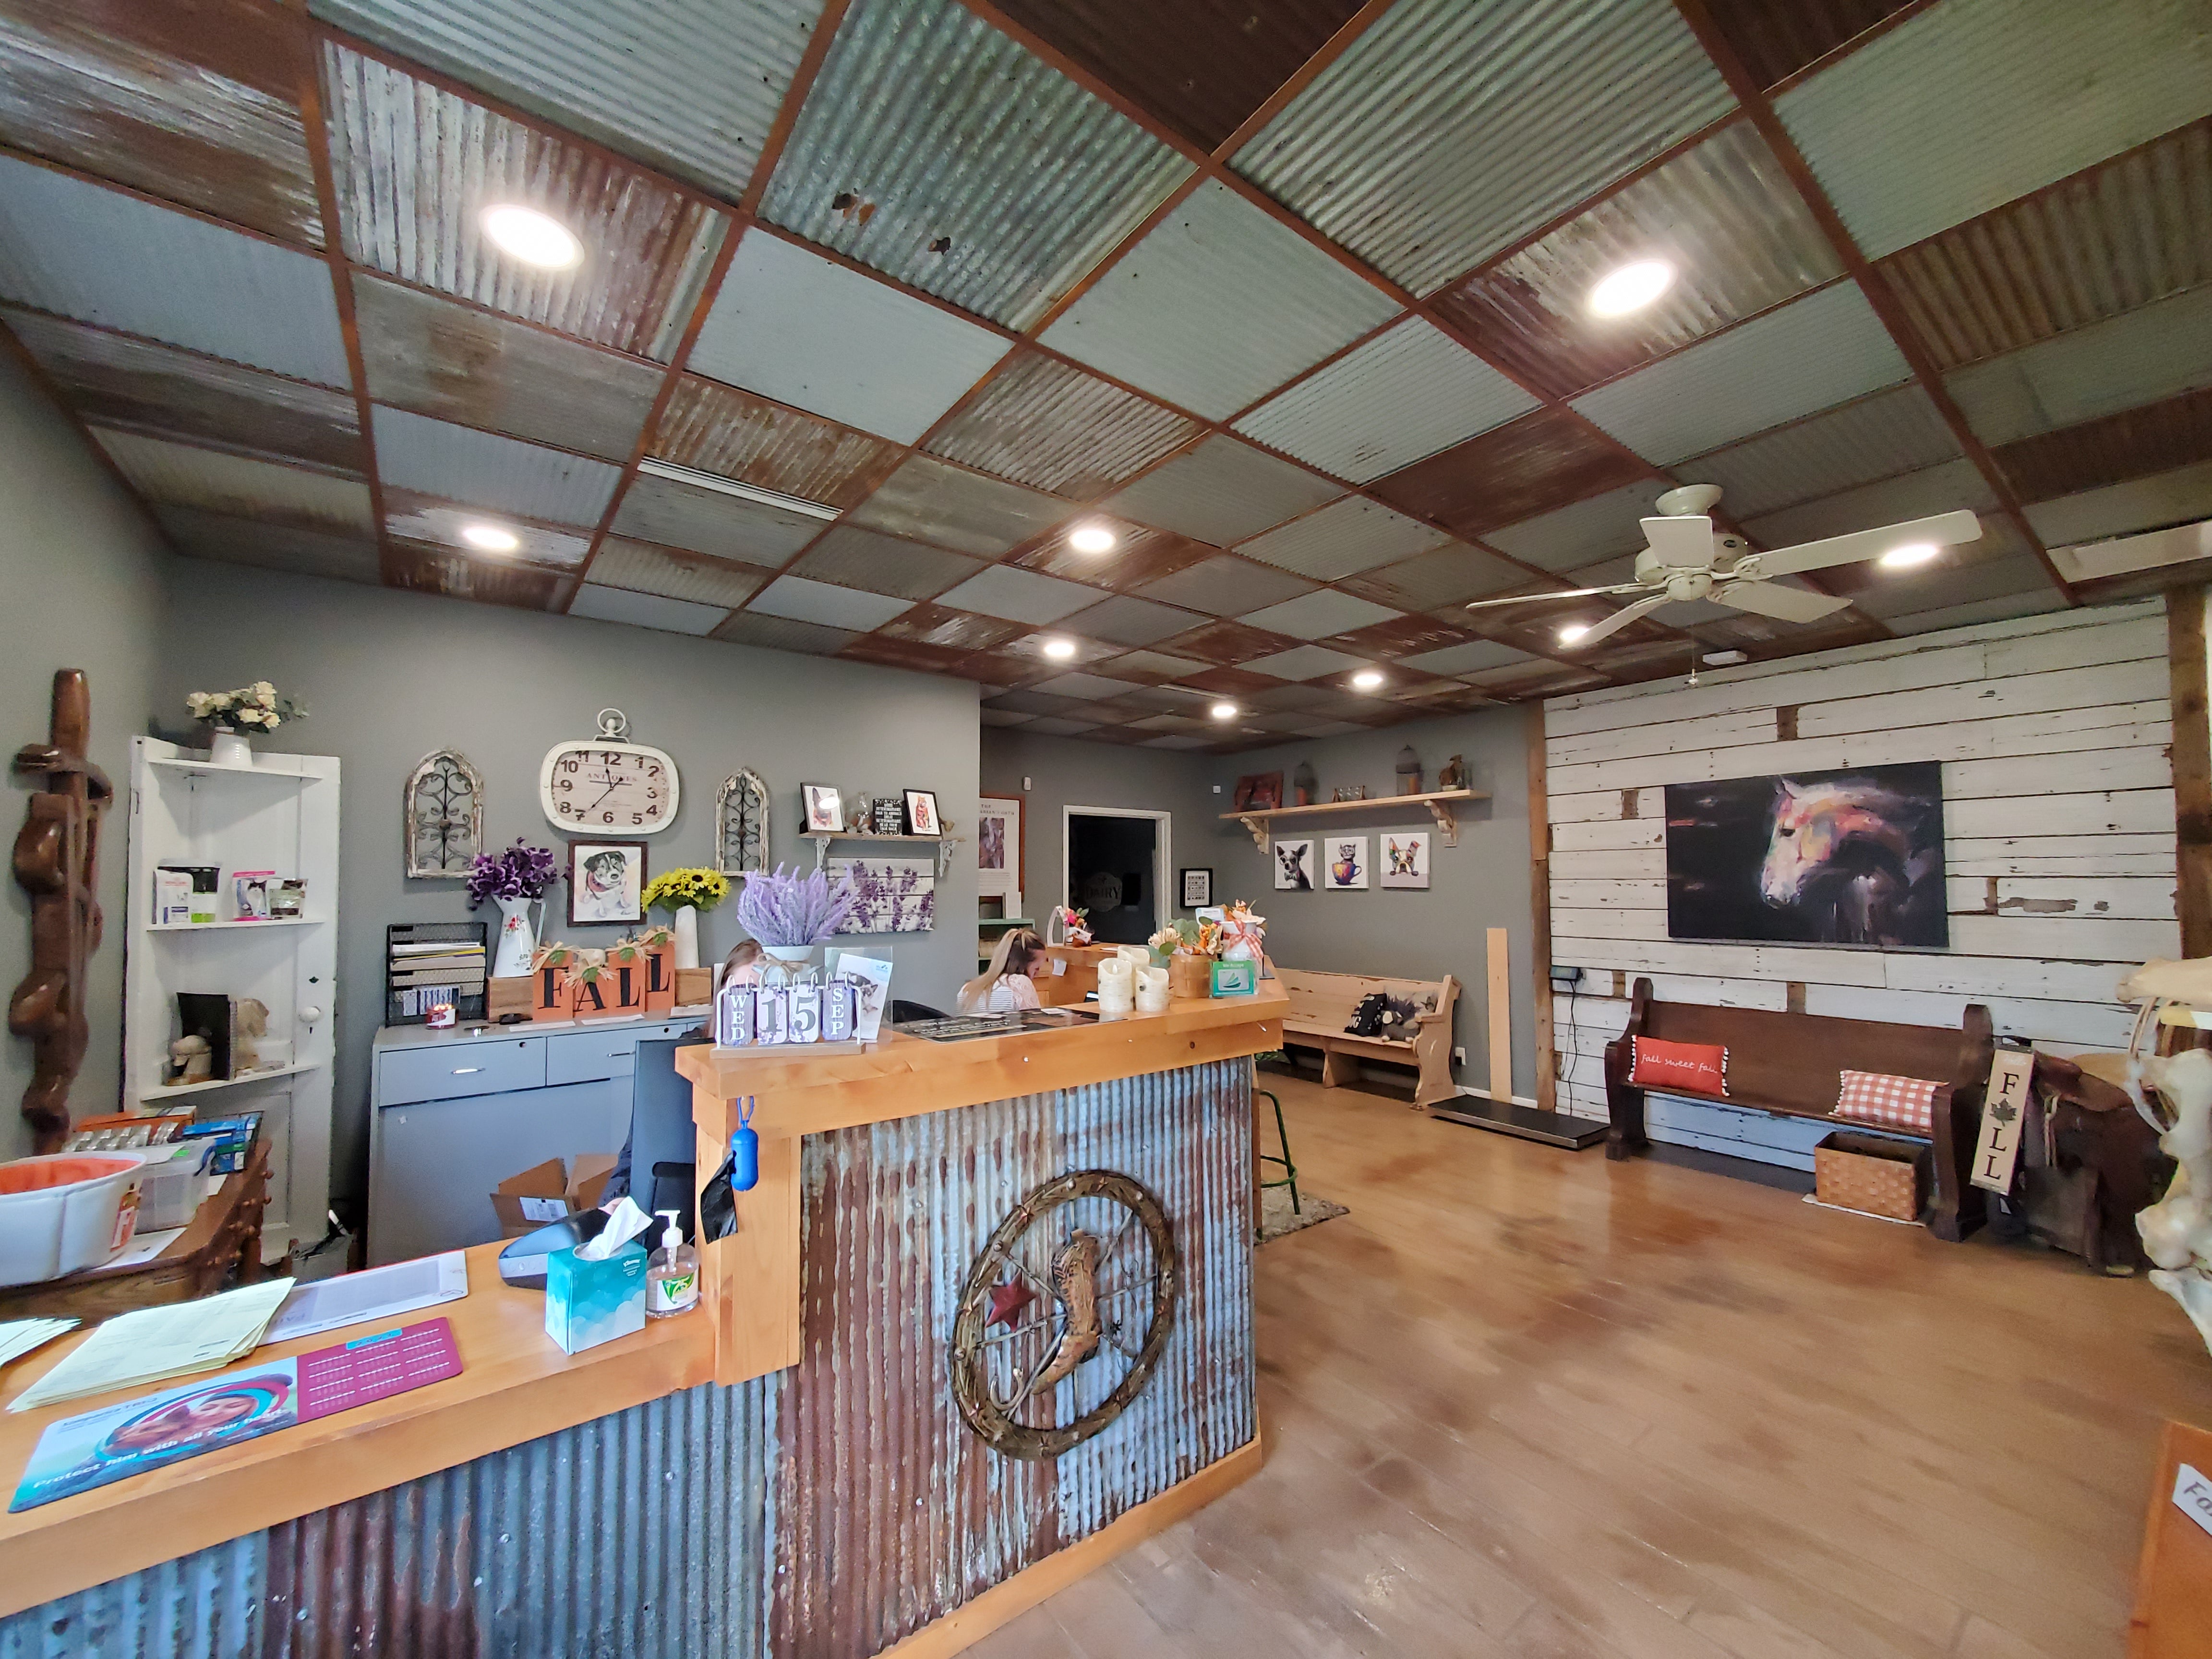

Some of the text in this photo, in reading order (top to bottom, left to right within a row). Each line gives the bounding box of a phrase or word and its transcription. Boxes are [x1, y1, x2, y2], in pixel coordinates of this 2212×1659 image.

[601, 752, 621, 766] 12
[635, 757, 644, 769] 1
[561, 760, 578, 773] 10
[648, 766, 660, 778] 2
[560, 780, 573, 792] 9
[647, 787, 658, 799] 3
[560, 802, 571, 814] 8
[646, 805, 658, 816] 4
[575, 809, 586, 821] 7
[602, 812, 614, 823] 6
[632, 813, 643, 825] 5
[539, 953, 671, 1011] FALL
[730, 988, 844, 1040] WED 15 SEP
[1641, 1054, 1662, 1064] fall
[1665, 1058, 1695, 1069] sweet
[34, 1463, 101, 1488] Protect
[106, 1453, 138, 1466] him
[142, 1440, 178, 1455] with
[183, 1431, 203, 1443] all
[207, 1422, 240, 1436] your
